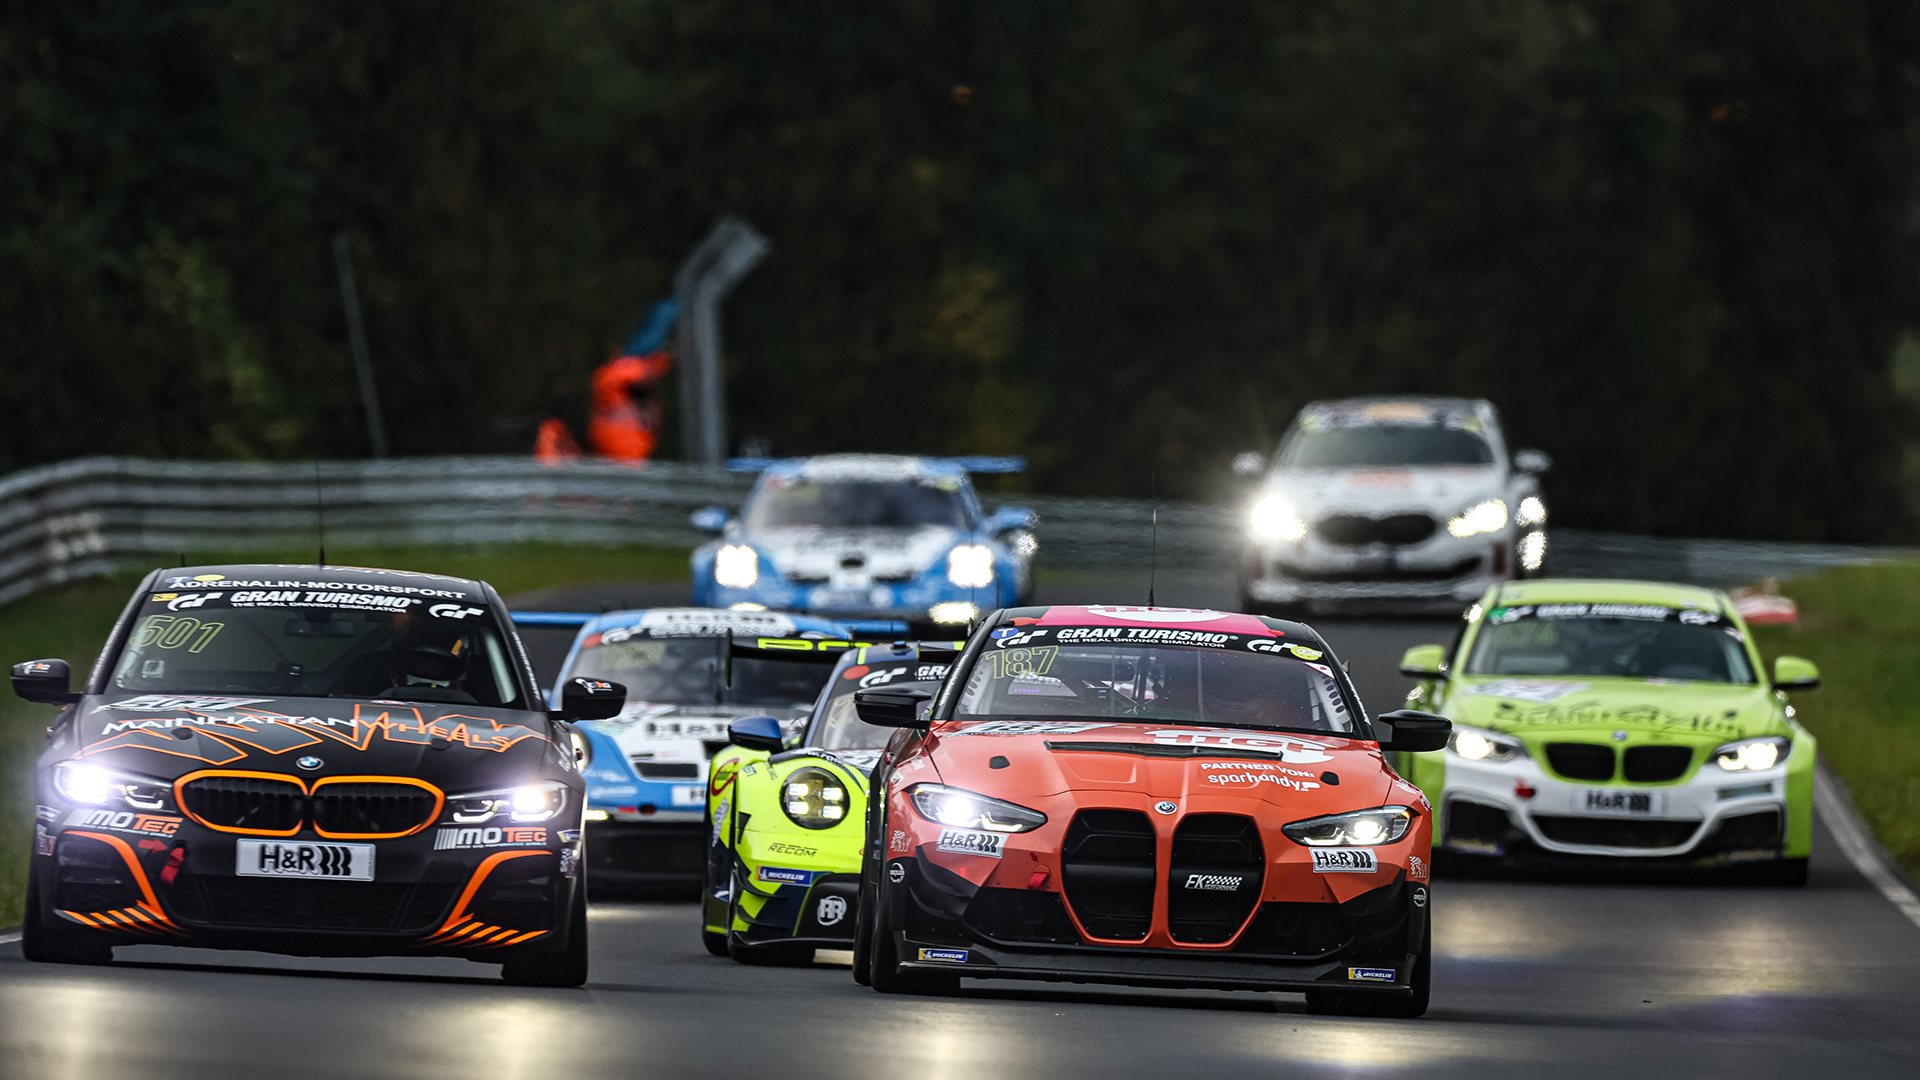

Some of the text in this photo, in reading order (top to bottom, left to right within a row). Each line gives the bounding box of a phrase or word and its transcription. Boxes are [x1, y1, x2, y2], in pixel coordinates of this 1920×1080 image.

[168, 580, 467, 599] ADRENALIN-MOTORSPORT
[229, 591, 302, 603] GRAN
[339, 604, 407, 614] SIMULATOR
[128, 614, 225, 654] 501
[1056, 627, 1127, 640] GRAN
[1160, 639, 1226, 649] SIMULATOR
[985, 645, 1059, 680] 187
[101, 715, 357, 736] MAINHATTAN
[1200, 762, 1316, 779] PARTNER VON:
[1207, 771, 1303, 792] sparhandy
[940, 831, 978, 849] H&R
[260, 843, 316, 872] H&R
[767, 842, 818, 858] RECOM
[1314, 850, 1351, 866] H&R
[768, 872, 806, 881] MICHELIN
[1184, 874, 1209, 889] FK
[931, 952, 964, 960] MICHELIN
[1362, 971, 1393, 979] MICHELIN
